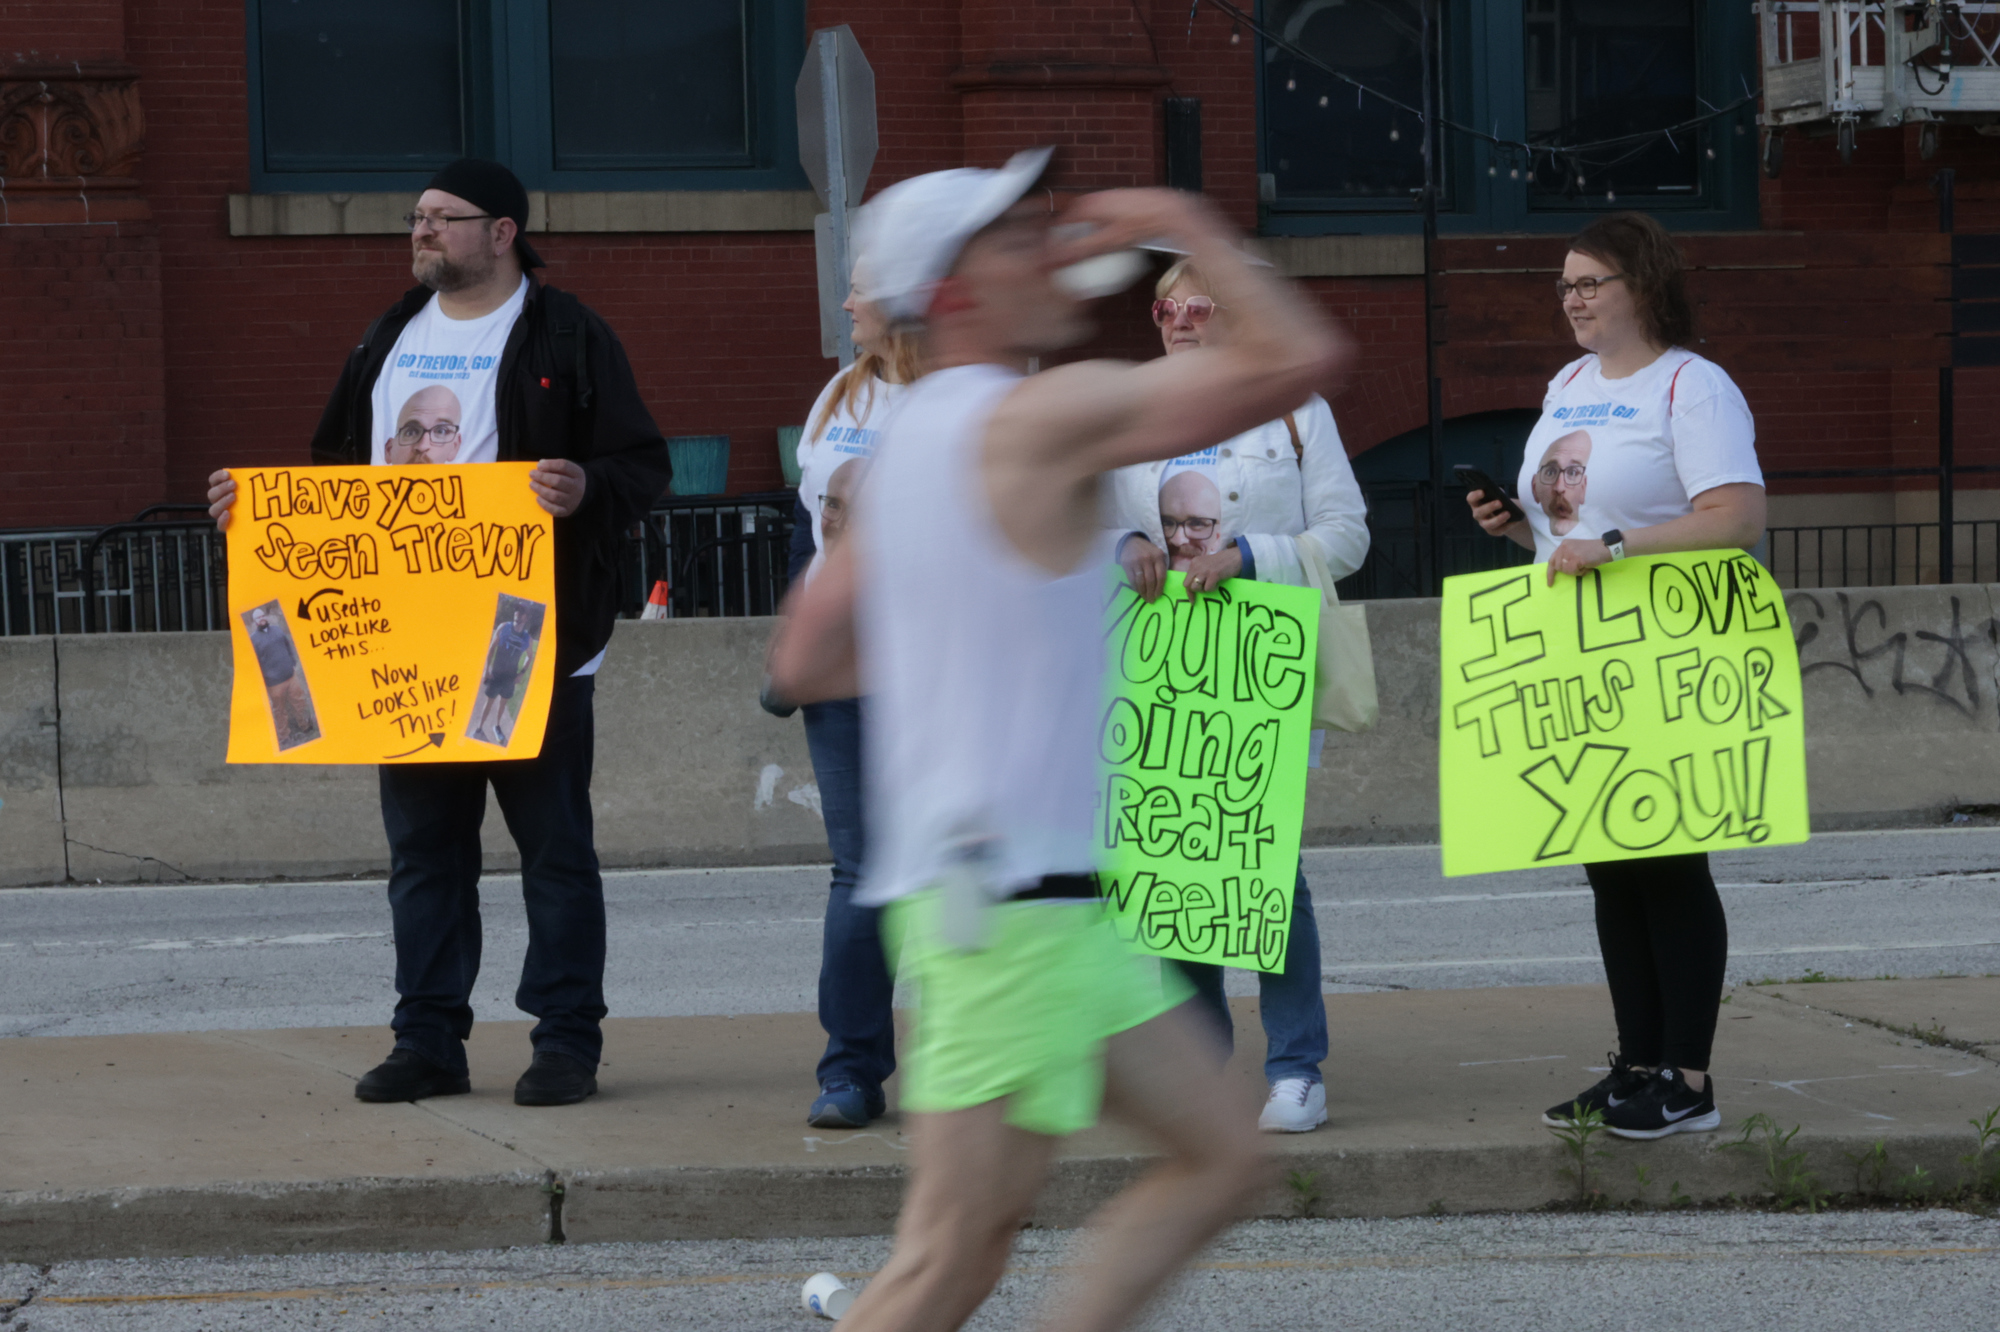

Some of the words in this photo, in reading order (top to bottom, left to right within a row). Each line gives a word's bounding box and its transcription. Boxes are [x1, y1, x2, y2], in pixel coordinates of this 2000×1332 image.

[397, 353, 417, 368] GO
[471, 355, 497, 370] GO!
[1552, 407, 1574, 420] GO
[1611, 405, 1640, 420] GO!
[825, 426, 844, 442] GO
[249, 470, 370, 522] Have
[376, 474, 466, 531] you
[254, 522, 379, 580] Seen
[389, 522, 546, 581] Trevor
[360, 597, 381, 614] to
[1459, 573, 1546, 683] I
[1575, 554, 1781, 654] LOVE
[309, 623, 354, 649] LOOK
[371, 663, 418, 689] Now
[1453, 658, 1634, 759] THIS
[1655, 646, 1791, 732] FOR
[1098, 686, 1280, 816] oing
